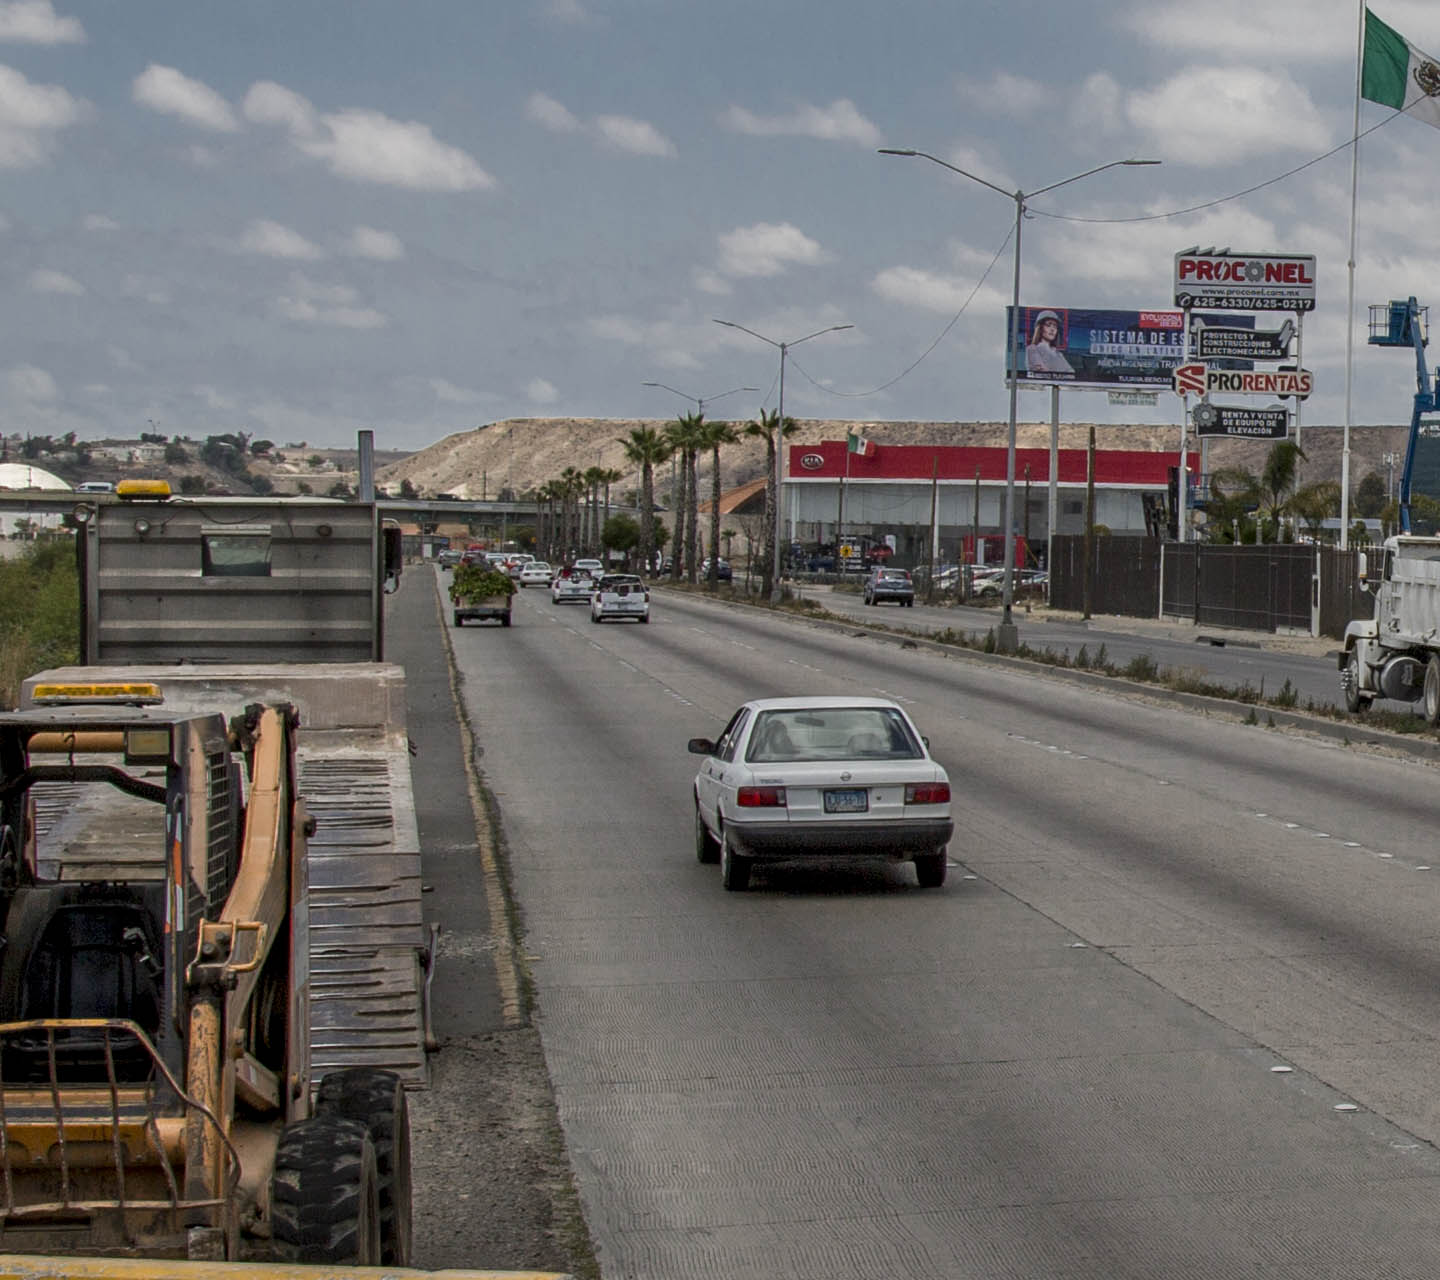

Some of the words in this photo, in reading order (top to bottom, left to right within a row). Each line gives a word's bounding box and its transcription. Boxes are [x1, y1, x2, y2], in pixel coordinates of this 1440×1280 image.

[1194, 298, 1311, 308] 625-6330/625-0217
[1090, 330, 1143, 344] SISTEMA
[1150, 332, 1165, 345] DE
[1203, 332, 1247, 340] PROYECTOS
[1203, 339, 1271, 348] CONSTRUCCIONES
[1207, 373, 1311, 392] PRORENTAS
[1222, 411, 1248, 419] RENTA
[1258, 412, 1284, 420] VENTA
[1235, 420, 1264, 428] EQUIPO
